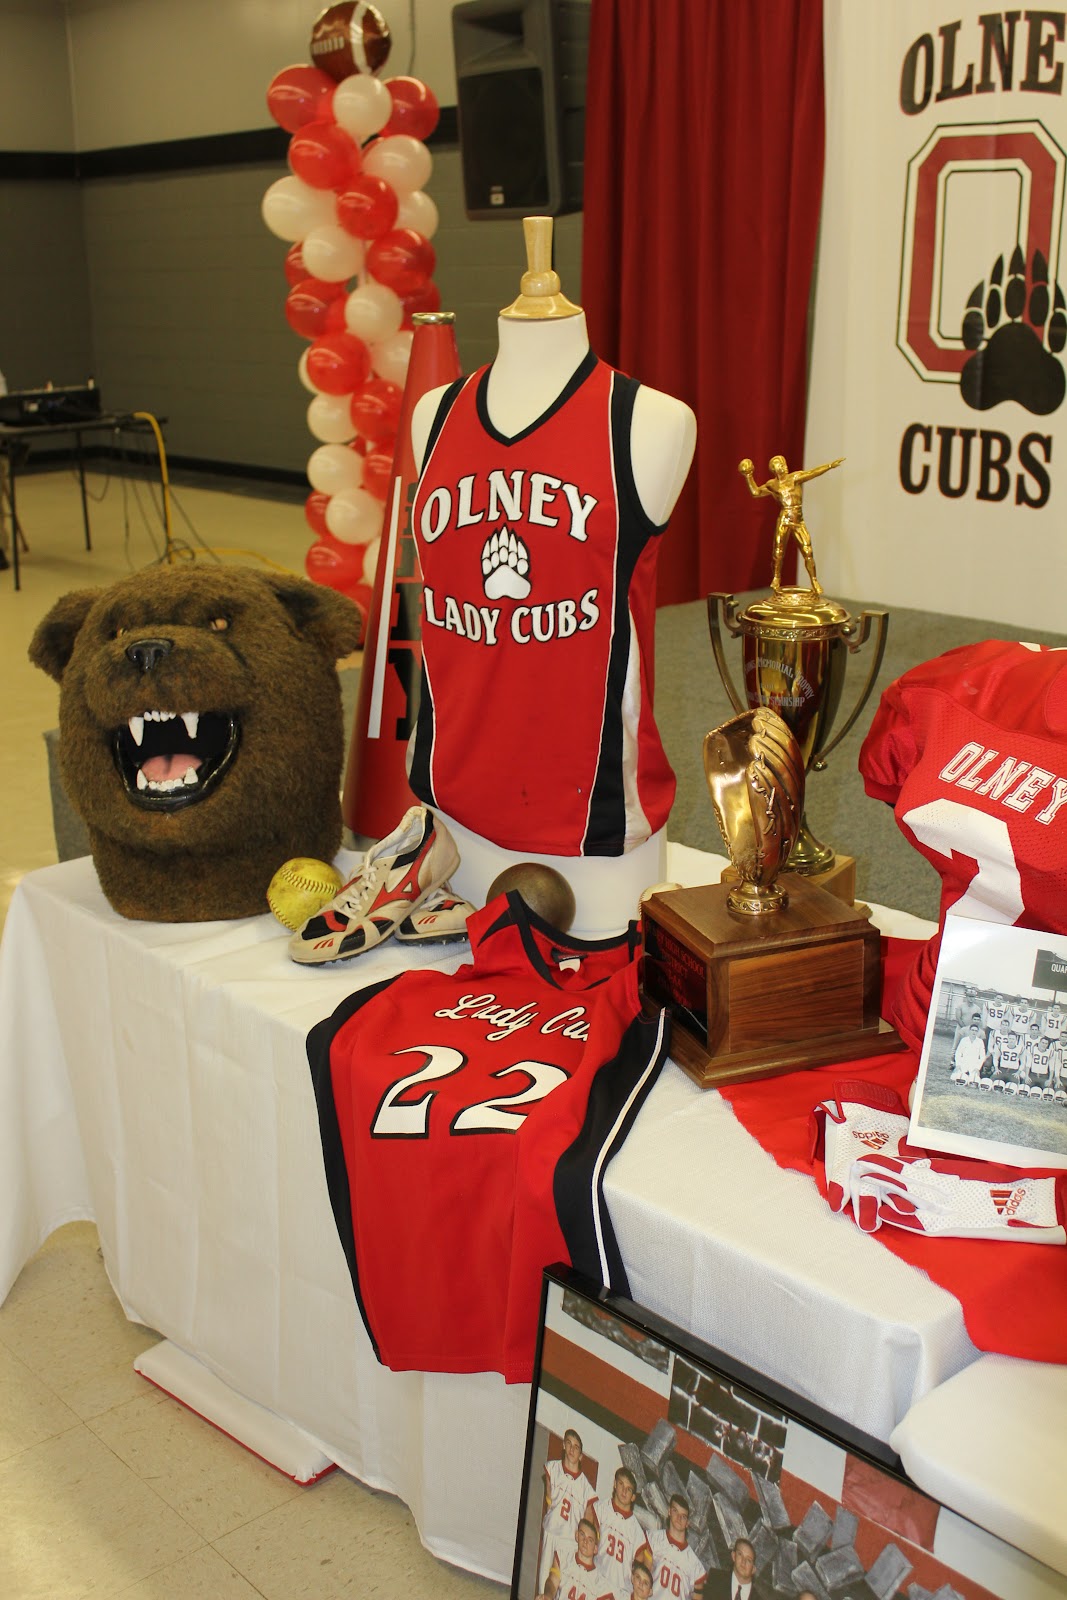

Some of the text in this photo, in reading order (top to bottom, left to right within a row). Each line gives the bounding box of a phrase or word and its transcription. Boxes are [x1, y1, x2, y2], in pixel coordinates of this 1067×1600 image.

[900, 423, 1052, 508] CUBS
[420, 469, 598, 543] OLNEY
[424, 586, 600, 646] LADY CUBS
[434, 993, 590, 1042] Lady Cu
[989, 1008, 1004, 1018] 85
[1016, 1014, 1028, 1024] 73
[1048, 1019, 1060, 1029] 51
[1003, 1051, 1017, 1061] 52
[1034, 1053, 1048, 1065] 20
[370, 1045, 572, 1139] 22
[852, 1130, 889, 1142] adidas
[560, 1498, 571, 1521] 2
[606, 1534, 625, 1563] 33
[660, 1565, 681, 1597] 00
